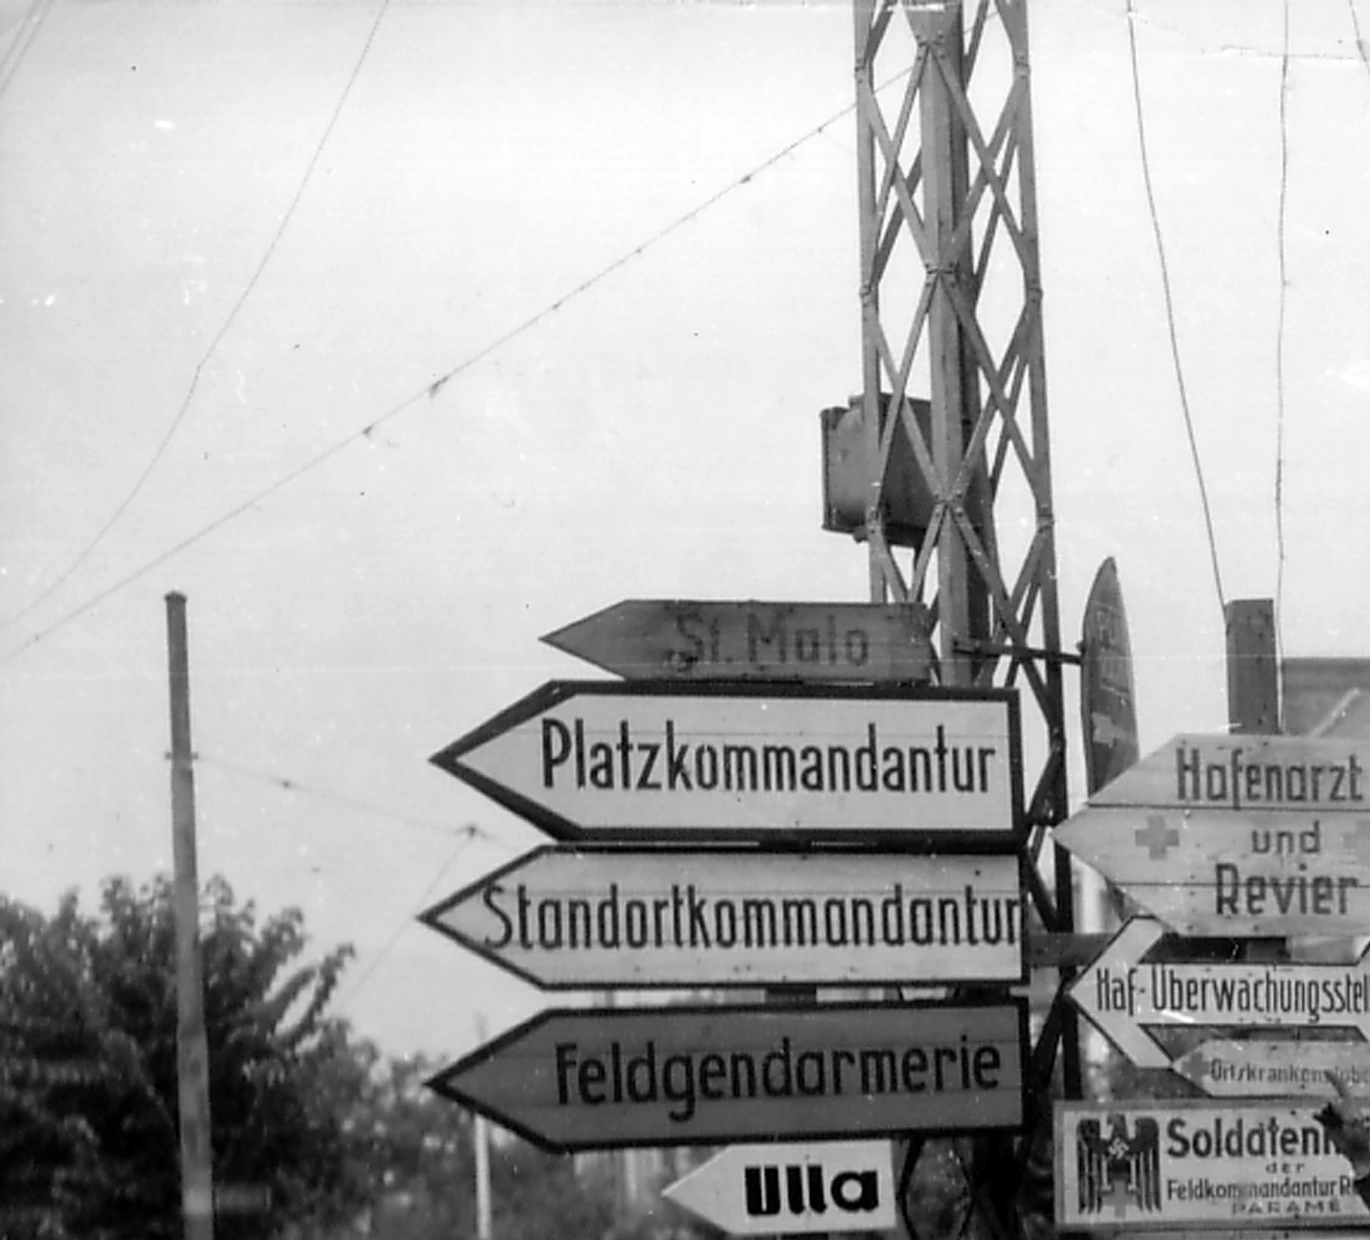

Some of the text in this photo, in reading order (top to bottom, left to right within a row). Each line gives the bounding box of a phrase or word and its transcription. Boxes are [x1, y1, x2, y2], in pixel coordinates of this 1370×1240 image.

[746, 610, 870, 668] Malo
[541, 719, 996, 793] Platzkommandantur
[1175, 746, 1364, 810] Hafenarzt
[1250, 820, 1321, 855] und
[482, 883, 1022, 949] Standortkommandantur
[1215, 862, 1359, 916] Revier
[555, 1034, 1001, 1123] Feldgendarmerie
[1265, 1161, 1306, 1174] der
